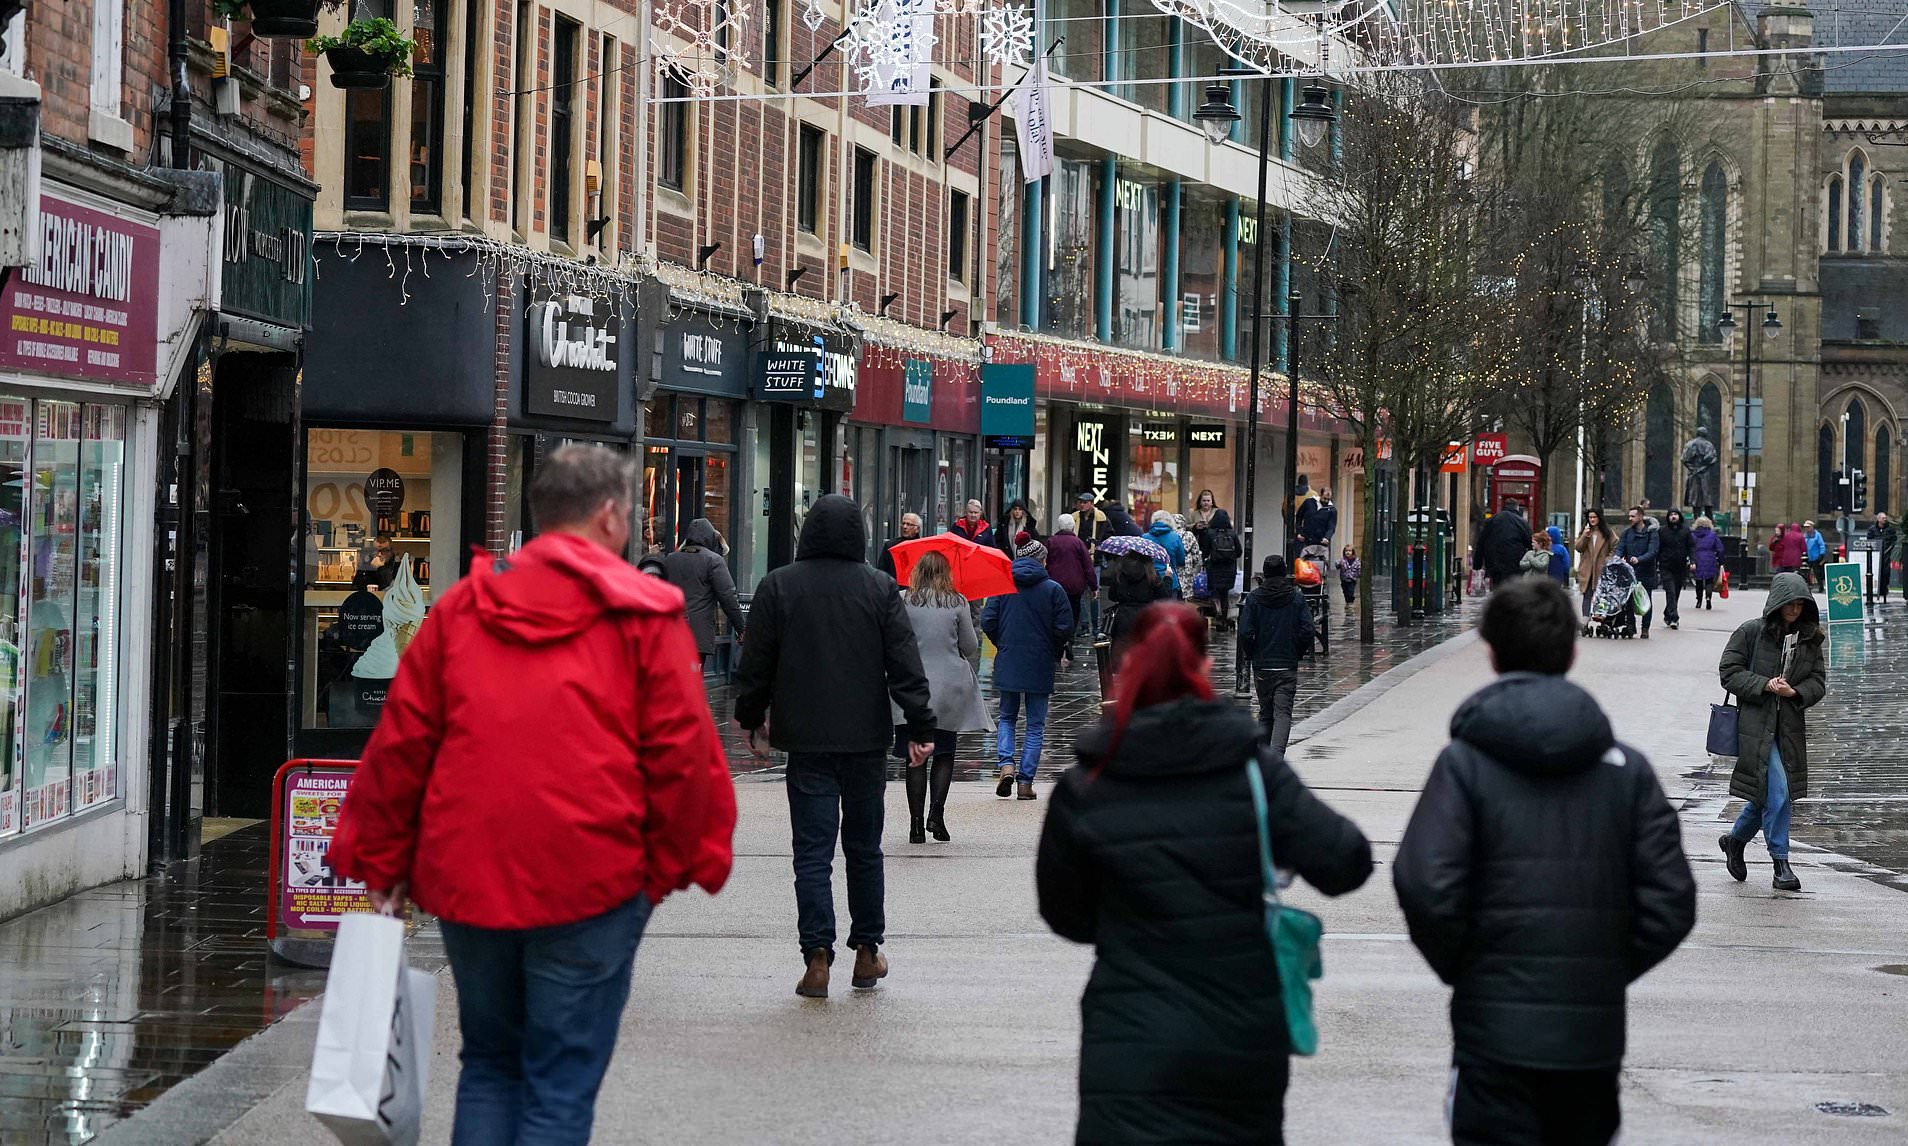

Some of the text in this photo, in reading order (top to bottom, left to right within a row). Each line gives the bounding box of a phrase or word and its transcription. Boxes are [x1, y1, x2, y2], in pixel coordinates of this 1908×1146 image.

[1115, 178, 1143, 212] NEXT
[22, 211, 134, 303] MERICAN CANDY
[683, 332, 722, 365] WHITE STUFF
[767, 359, 806, 371] WHITE
[764, 376, 804, 388] STUFF
[1077, 421, 1104, 452] NEXT
[1191, 431, 1223, 442] NEXT
[1479, 441, 1501, 449] FIVE
[1476, 449, 1504, 457] GUYS
[360, 614, 382, 623] serving
[297, 778, 348, 790] AMERICAN
